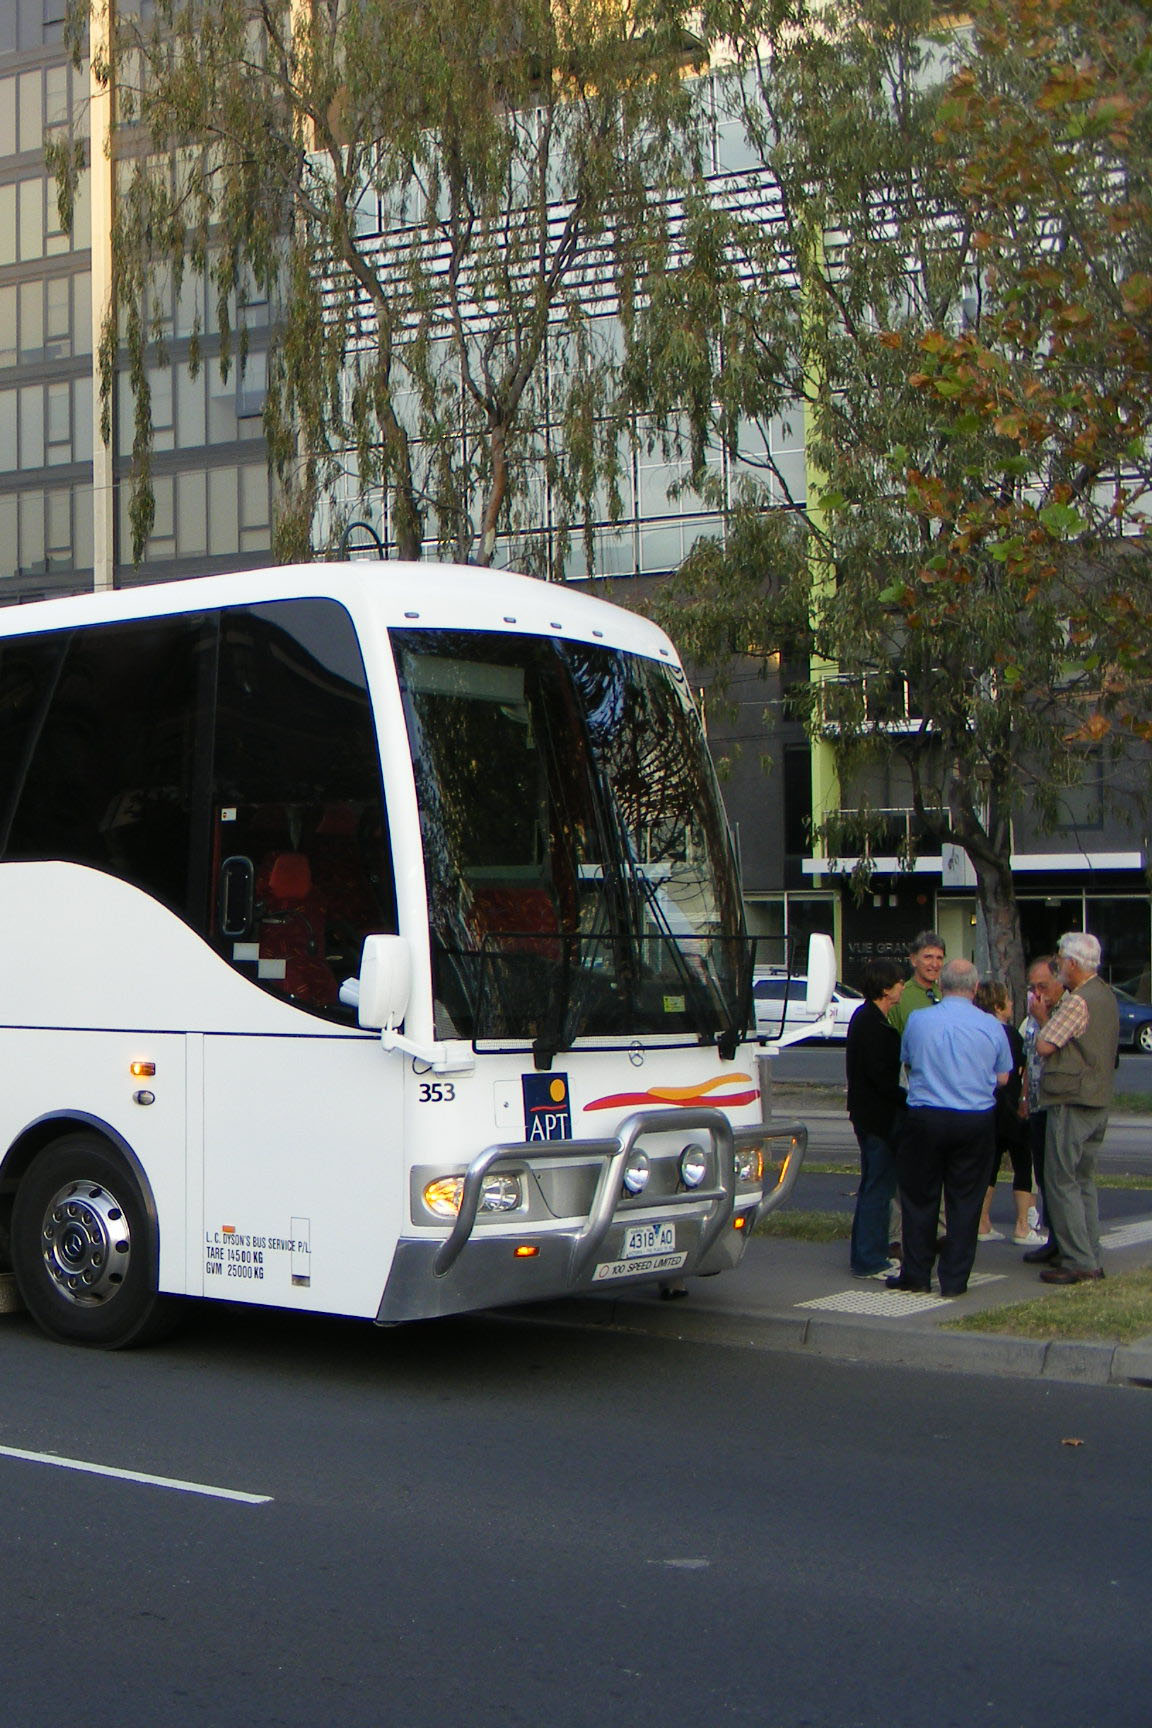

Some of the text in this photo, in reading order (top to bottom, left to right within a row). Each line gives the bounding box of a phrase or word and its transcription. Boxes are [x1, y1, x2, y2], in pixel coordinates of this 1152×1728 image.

[877, 942, 912, 953] GRAN
[419, 1083, 456, 1102] 353
[530, 1113, 568, 1141] APT
[206, 1232, 212, 1243] L.
[214, 1232, 221, 1244] C.
[223, 1233, 251, 1247] DYSON'S
[252, 1236, 266, 1249] BUS
[268, 1238, 296, 1252] SERVICE
[630, 1233, 654, 1249] 4318
[206, 1246, 263, 1263] TARE 14500 KG
[206, 1261, 264, 1279] GVM 25000 KG
[612, 1256, 682, 1275] 100 SPEED LIMITED
